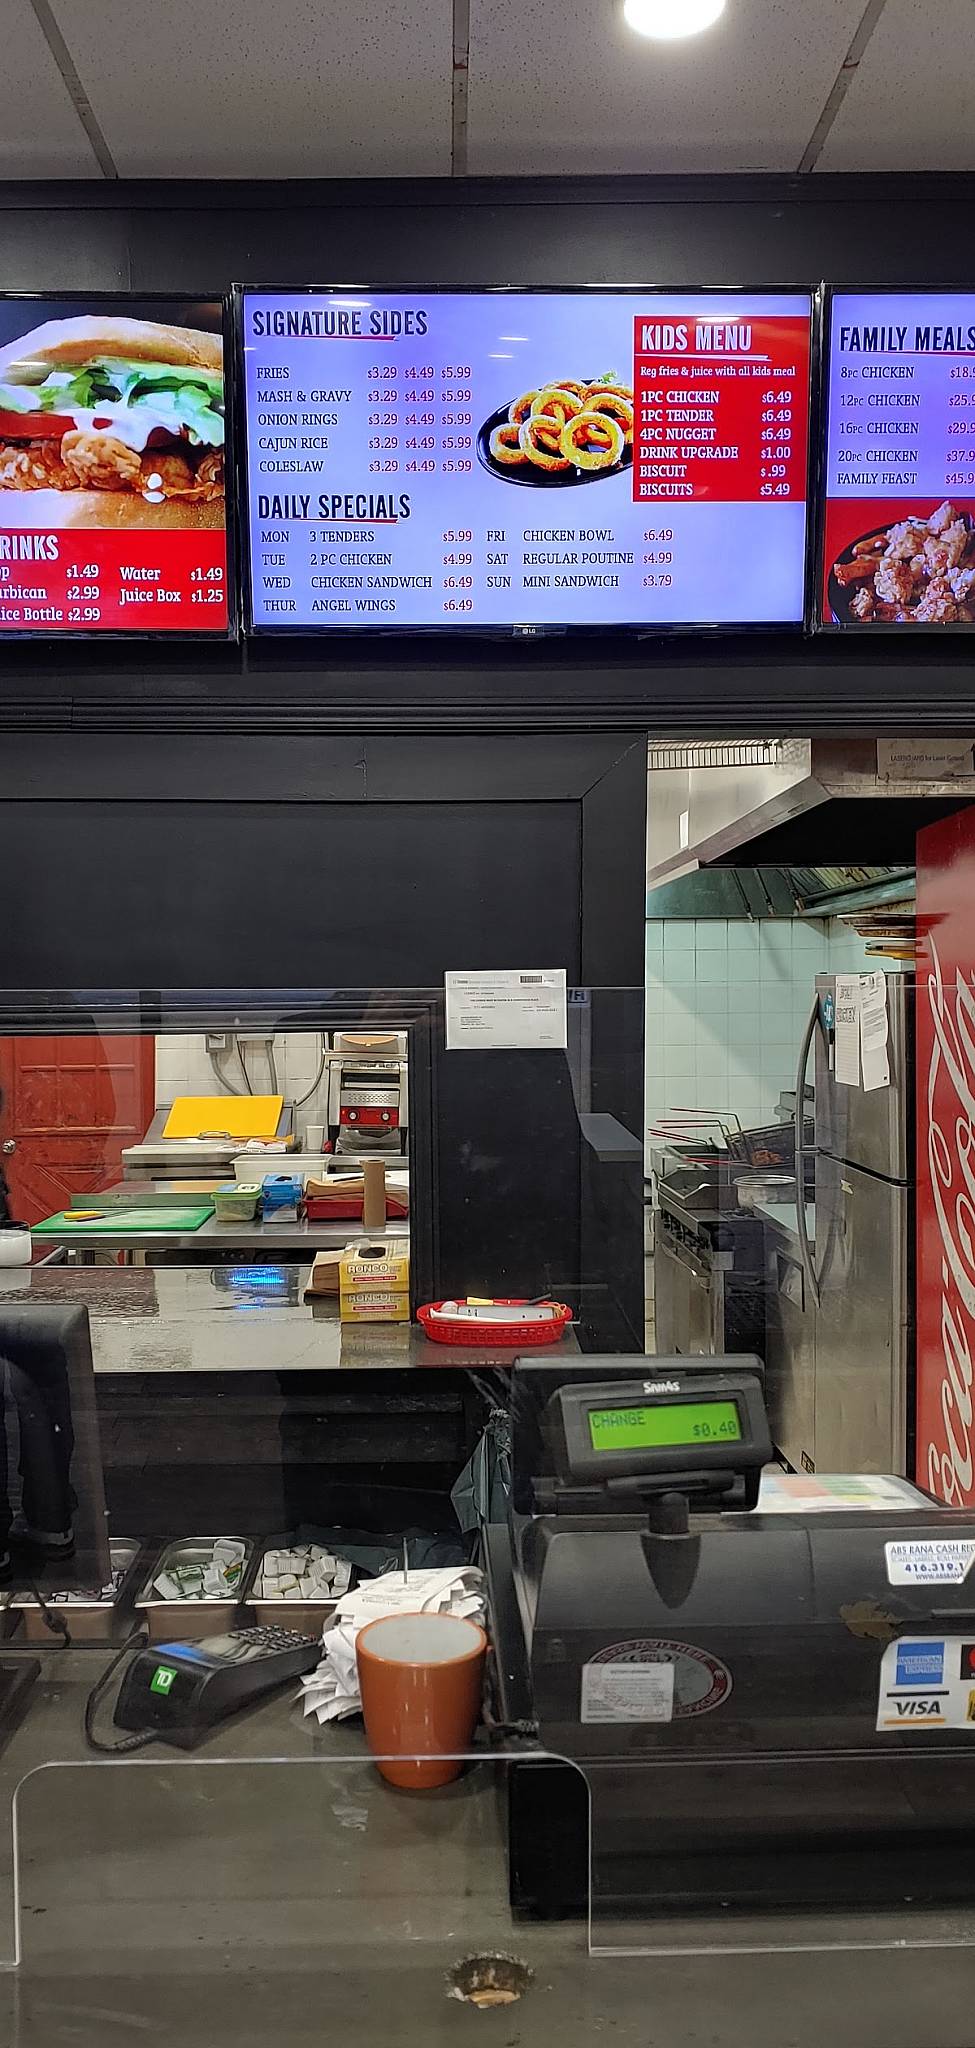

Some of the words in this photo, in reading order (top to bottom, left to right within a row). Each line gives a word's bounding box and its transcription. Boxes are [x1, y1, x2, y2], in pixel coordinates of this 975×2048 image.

[253, 310, 362, 336] SIGNATURE
[370, 310, 428, 336] SIDES
[642, 324, 688, 351] KIDS
[696, 324, 752, 351] MENU
[840, 327, 907, 351] FAMILY
[915, 327, 975, 351] MEALS
[257, 367, 290, 379] FRIES
[367, 366, 397, 379] $3.29
[404, 366, 434, 379] $4.49
[441, 366, 471, 379] $5.99
[640, 367, 656, 378] Reg
[658, 366, 679, 376] fries
[681, 367, 689, 376] &
[691, 367, 713, 378] juice
[715, 366, 736, 376] with
[738, 366, 750, 376] all
[752, 366, 772, 376] kids
[773, 366, 796, 376] meal
[862, 367, 914, 378] CHICKEN
[258, 391, 292, 402] MASH
[296, 391, 306, 402] &
[310, 391, 352, 402] GRAVY
[368, 390, 397, 402] $3.29
[404, 390, 435, 402] $4.49
[441, 390, 471, 402] $5.99
[641, 391, 662, 404] 1PC
[666, 391, 719, 404] CHICKEN
[761, 391, 792, 404] $6.49
[868, 395, 920, 406] CHICKEN
[258, 414, 298, 425] ONION
[302, 414, 338, 425] RINGS
[368, 413, 398, 425] $3.29
[405, 413, 435, 425] $4.49
[442, 413, 472, 425] $5.99
[641, 410, 662, 422] 1PC
[666, 410, 713, 422] TENDER
[761, 409, 792, 422] $6.49
[640, 429, 662, 441] 4PC
[666, 428, 716, 440] NUGGET
[761, 428, 791, 441] $6.49
[867, 423, 919, 434] CHICKEN
[259, 437, 297, 451] CAJUN
[301, 437, 328, 449] RICE
[369, 437, 398, 449] $3.29
[405, 437, 435, 449] $4.49
[442, 437, 472, 449] $5.99
[640, 447, 678, 459] DRINK
[682, 447, 738, 459] UPGRADE
[761, 447, 791, 459] $1.00
[866, 450, 918, 461] CHICKEN
[259, 461, 323, 472] COLESLAW
[369, 460, 398, 472] $3.29
[406, 460, 435, 472] $4.49
[442, 460, 472, 472] $5.99
[640, 466, 687, 478] BISCUIT
[837, 473, 879, 484] FAMILY
[881, 473, 917, 484] FEAST
[640, 484, 693, 496] BISCUITS
[760, 483, 790, 496] $5.49
[258, 495, 311, 519] DAILY
[318, 494, 410, 519] SPECIALS
[261, 531, 290, 542] MON
[310, 531, 316, 542] 3
[320, 531, 375, 542] TENDERS
[443, 531, 472, 542] $5.99
[487, 531, 505, 542] FRI
[523, 530, 575, 541] CHICKEN
[579, 530, 614, 541] BOWL
[644, 530, 673, 541] $6.49
[0, 535, 59, 561] RINKS
[262, 554, 285, 565] TUE
[310, 554, 317, 565] 2
[321, 554, 336, 565] PC
[340, 554, 392, 565] CHICKEN
[443, 554, 472, 565] $4.99
[487, 554, 508, 565] SAT
[523, 553, 578, 564] REGULAR
[581, 553, 634, 564] POUTINE
[643, 553, 672, 564] $4.99
[66, 565, 99, 578] $1.49
[120, 567, 161, 580] Water
[190, 568, 223, 581] $1.49
[263, 577, 291, 588] WED
[311, 577, 363, 588] CHICKEN
[367, 577, 432, 588] SANDWICH
[443, 577, 472, 588] $6.49
[487, 577, 511, 588] SUN
[523, 576, 551, 587] MINI
[554, 576, 619, 587] SANDWICH
[642, 575, 672, 587] $3.79
[67, 586, 99, 599] $2.99
[119, 588, 153, 605] Juice
[156, 589, 181, 602] Box
[191, 589, 223, 603] $1.25
[263, 600, 296, 611] THUR
[312, 600, 351, 611] ANGEL
[355, 600, 396, 611] WINGS
[443, 600, 473, 611] $6.49
[0, 607, 20, 620] ice
[24, 607, 63, 621] Bottle
[68, 608, 100, 621] $2.99
[347, 1263, 388, 1274] RONCO
[347, 1293, 390, 1303] RONCO
[592, 1411, 646, 1429] CHANGE
[692, 1420, 737, 1437] $0.40
[891, 1545, 907, 1554] ABS
[909, 1545, 934, 1554] RANA
[936, 1544, 959, 1553] CASH
[157, 1670, 172, 1687] TD
[893, 1701, 941, 1715] VISA
